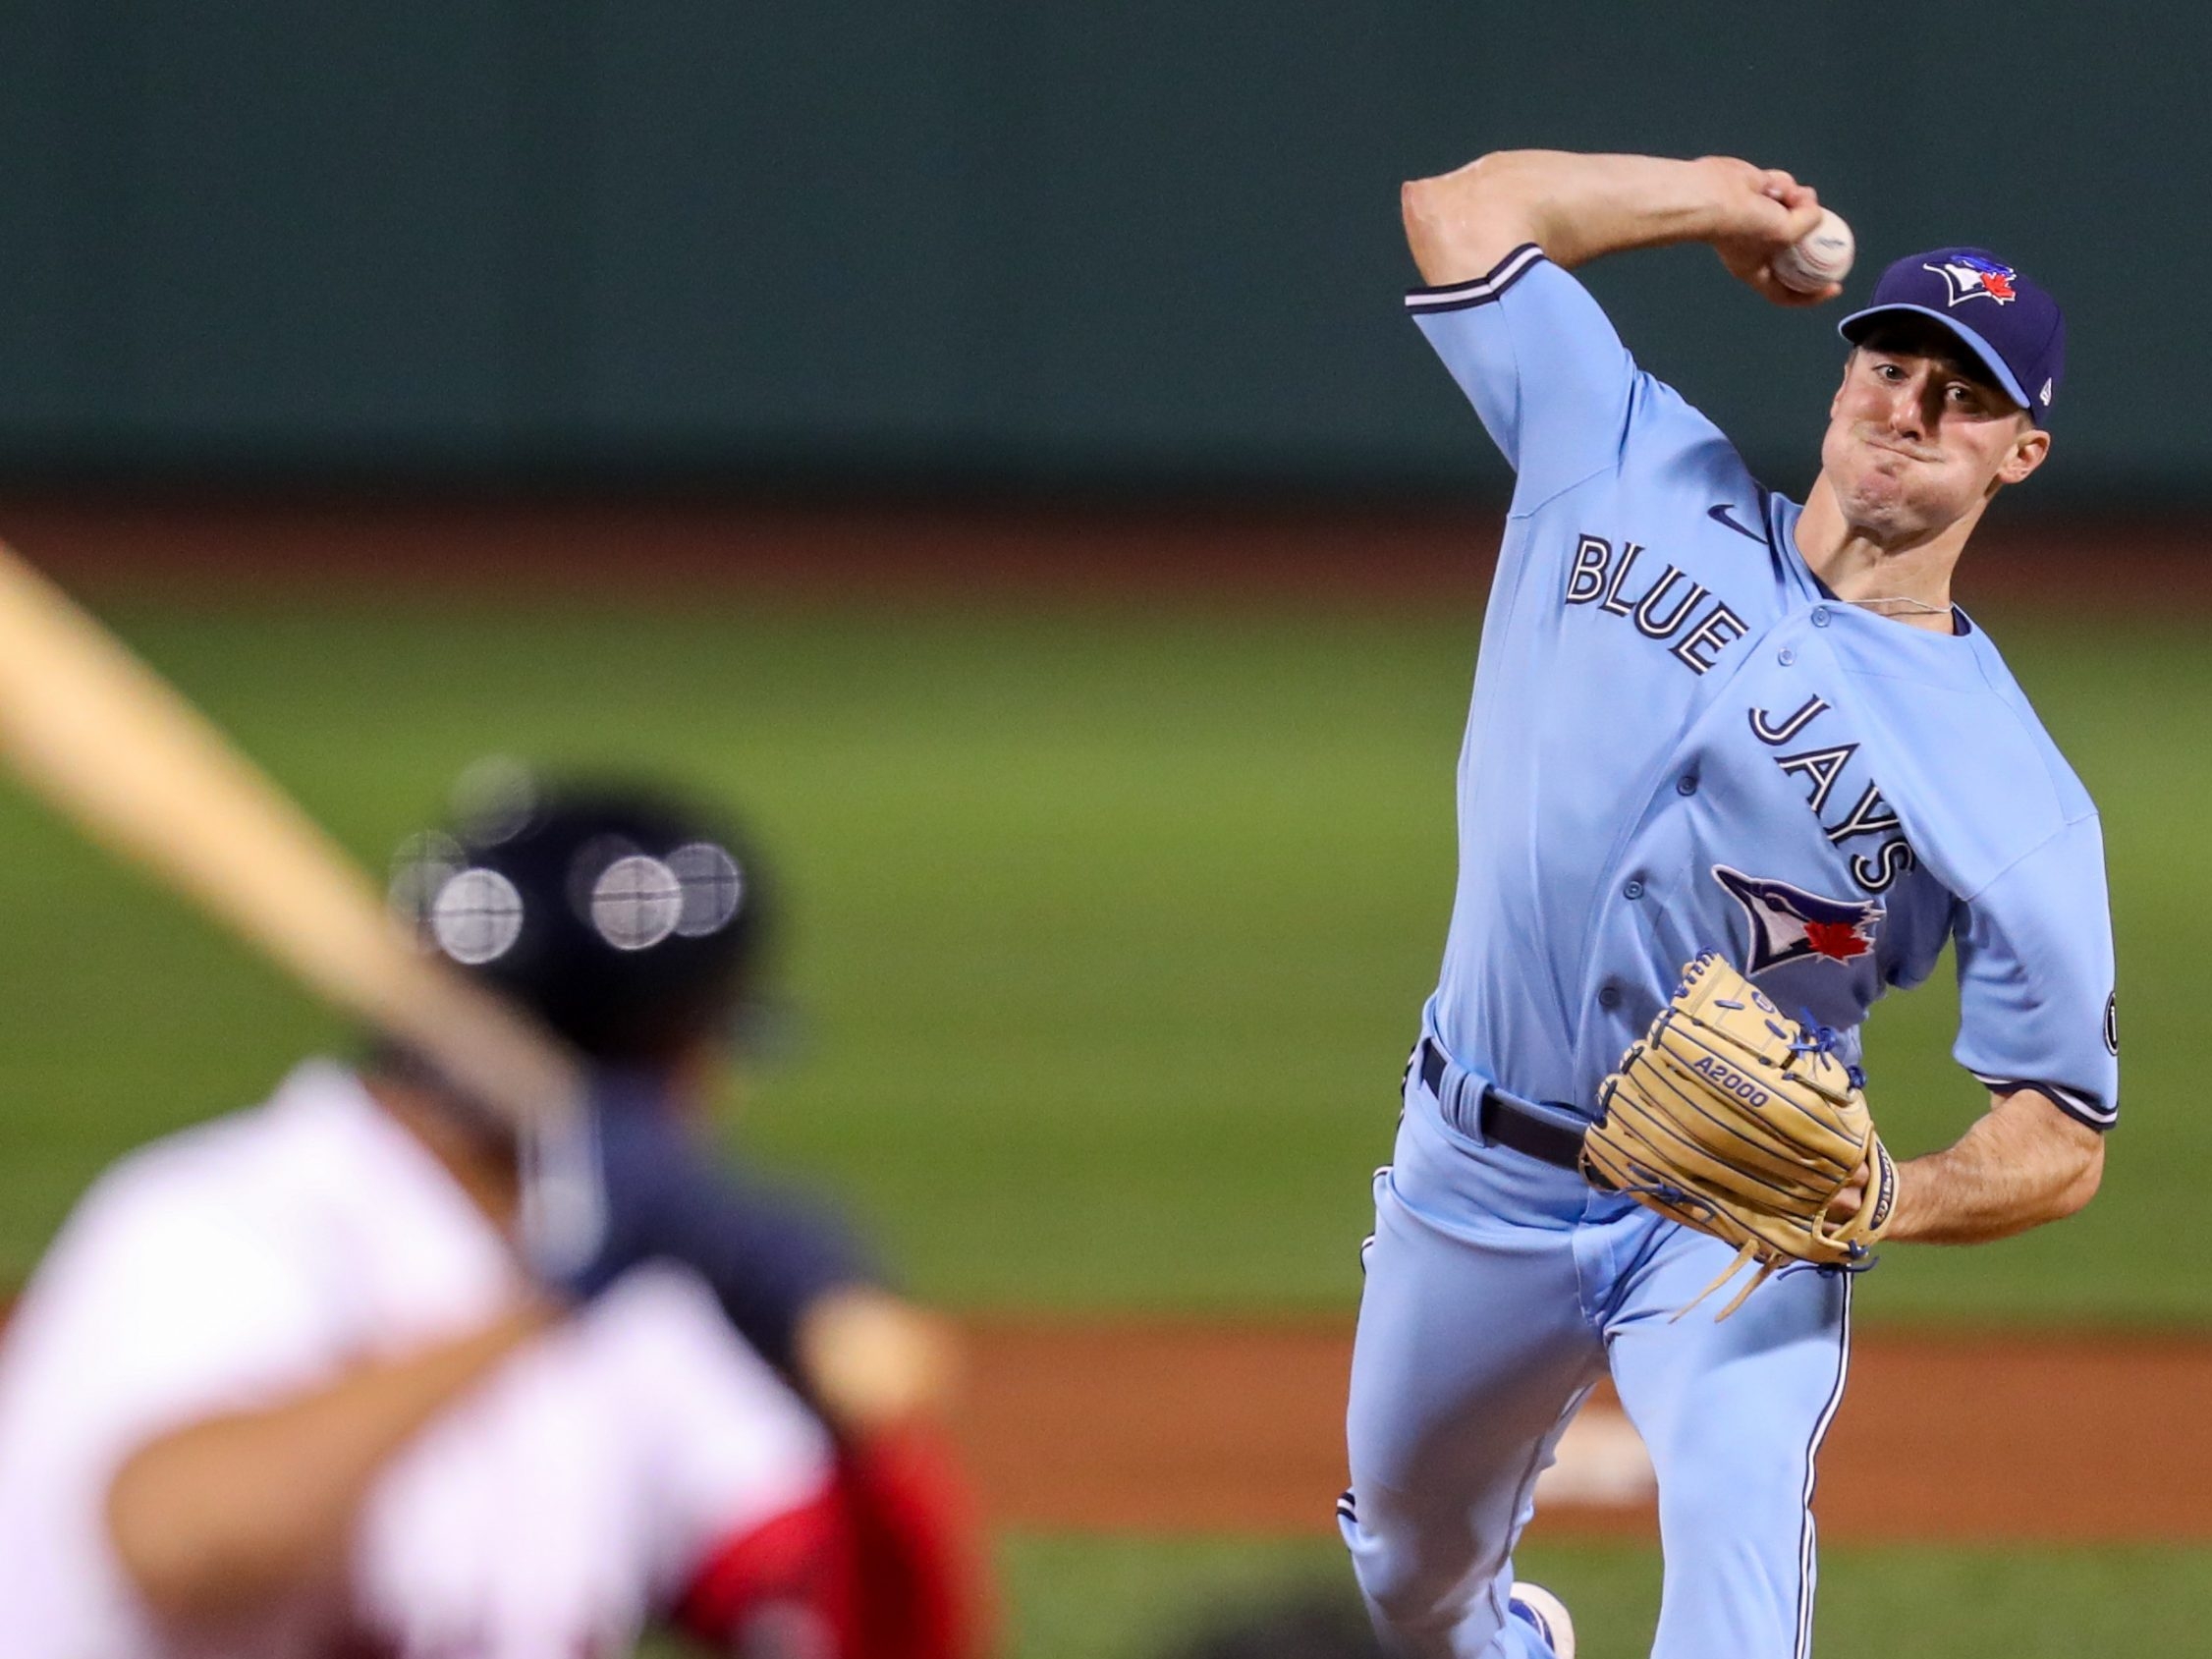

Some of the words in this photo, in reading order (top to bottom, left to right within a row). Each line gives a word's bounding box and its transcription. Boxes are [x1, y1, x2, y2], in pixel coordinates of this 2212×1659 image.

[1565, 533, 1749, 676] BLUE
[1748, 693, 1916, 894] JAYS
[1694, 1056, 1769, 1108] A2000
